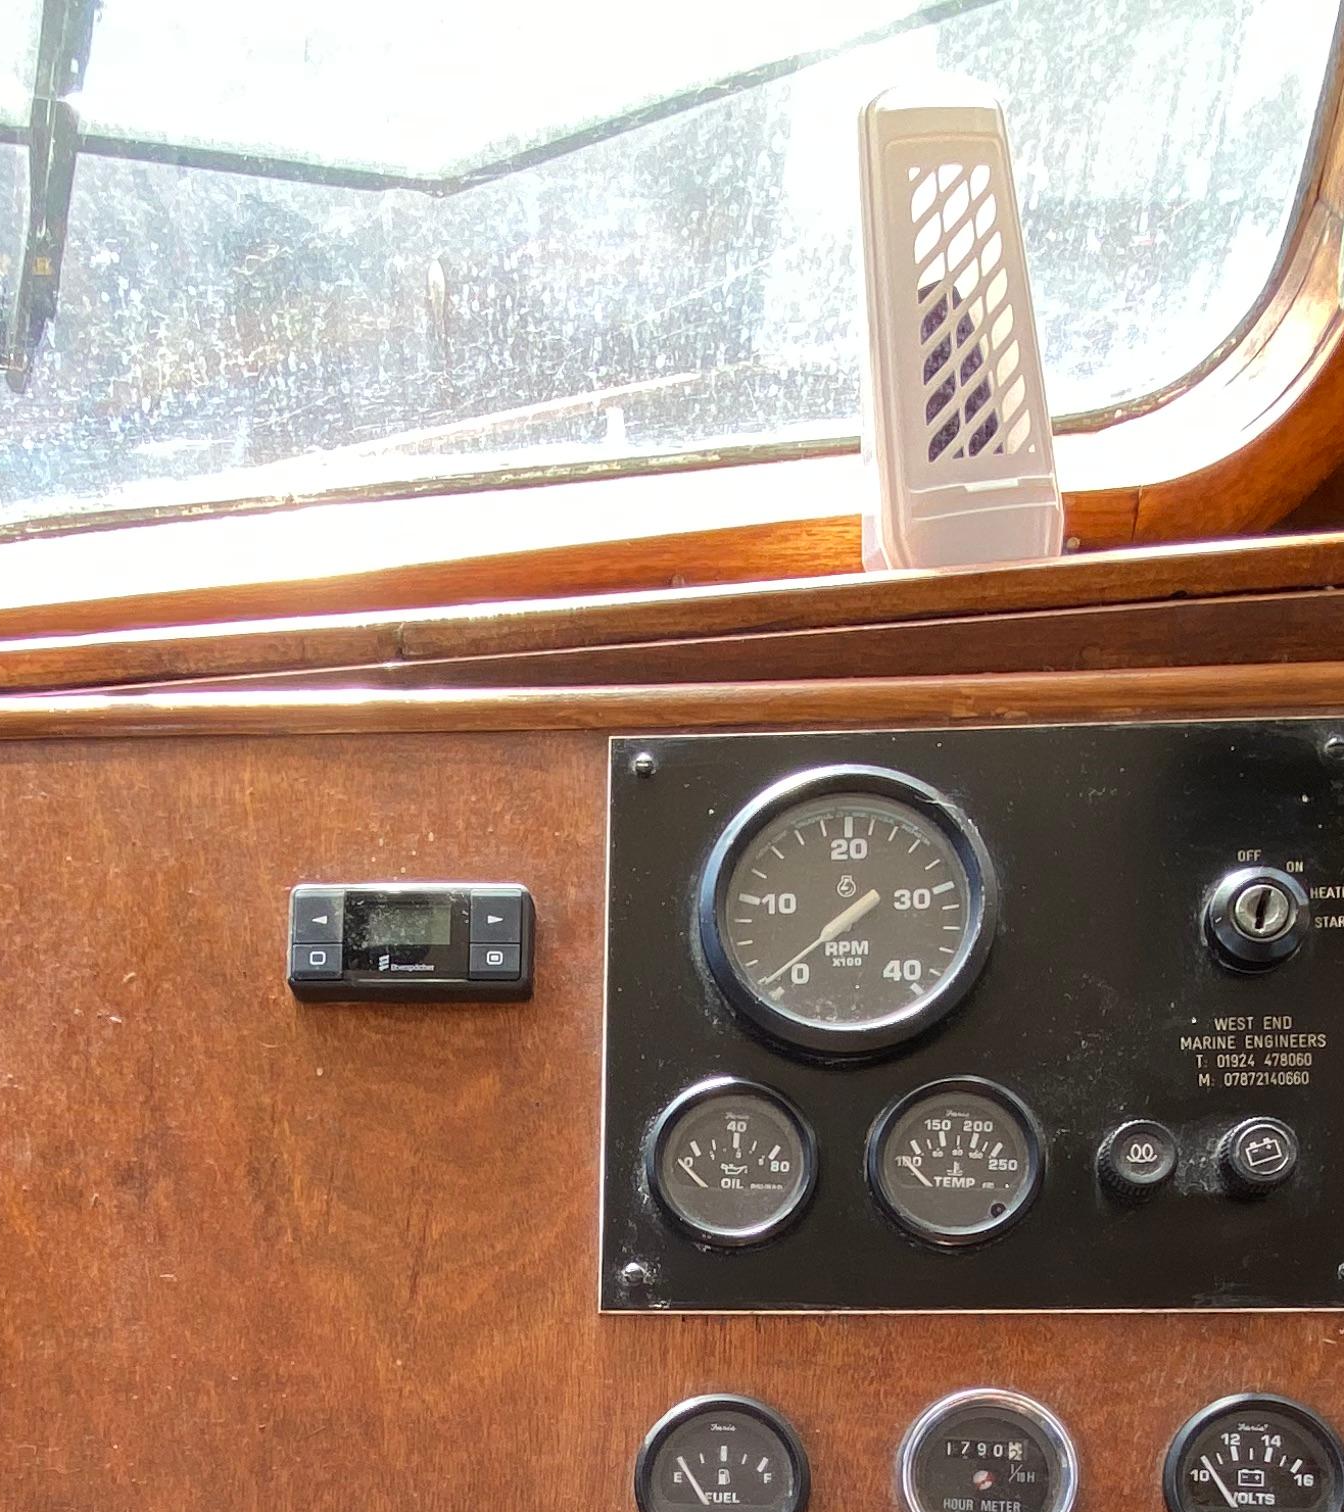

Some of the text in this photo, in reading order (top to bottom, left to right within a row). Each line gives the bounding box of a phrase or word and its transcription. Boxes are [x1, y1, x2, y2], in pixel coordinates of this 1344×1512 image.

[830, 838, 869, 861] 20
[1237, 849, 1262, 863] OFF
[1286, 861, 1304, 873] ON
[762, 892, 798, 915] 10
[893, 888, 932, 911] 30
[824, 940, 869, 957] RPM
[832, 957, 862, 968] X100
[790, 962, 810, 985] 0
[882, 959, 922, 982] 40
[1214, 1016, 1293, 1031] WEST END
[1180, 1034, 1327, 1050] MARINE ENGINEERS
[1217, 1054, 1256, 1068] 01924
[1264, 1053, 1313, 1067] 478060
[1224, 1071, 1311, 1087] 07872140660
[726, 1120, 748, 1133] 40
[924, 1119, 952, 1131] 150
[963, 1120, 994, 1132] 200
[770, 1160, 791, 1173] 80
[988, 1159, 1018, 1171] 250
[720, 1177, 744, 1190] OIL
[933, 1176, 976, 1188] TEMP
[1221, 1433, 1240, 1446] 12
[1261, 1434, 1281, 1447] 14
[673, 1471, 683, 1483] E
[763, 1473, 772, 1484] F
[1190, 1469, 1210, 1482] 10
[1294, 1474, 1315, 1487] 16
[704, 1492, 741, 1504] FUEL
[943, 1498, 1022, 1512] HOUR METER
